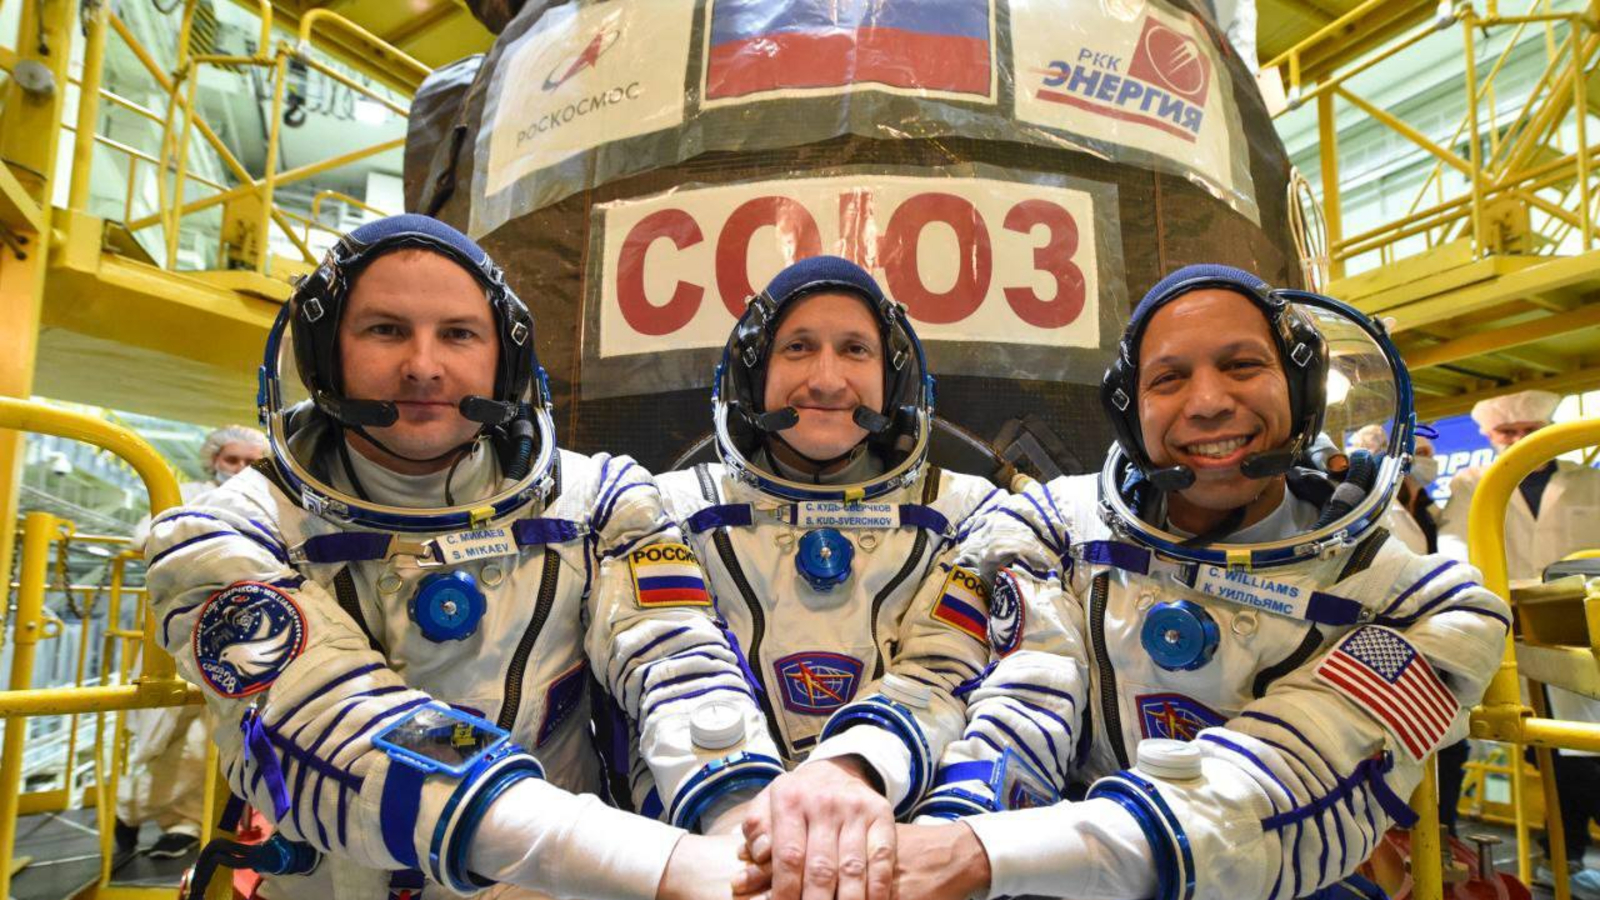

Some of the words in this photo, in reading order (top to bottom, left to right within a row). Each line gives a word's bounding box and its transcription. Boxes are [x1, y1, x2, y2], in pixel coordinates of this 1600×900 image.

[1078, 47, 1122, 71] РКК
[1043, 60, 1204, 134] ЭНЕРГИЯ
[516, 82, 640, 147] РОСКОСМОС
[617, 192, 1086, 336] СОЮЗ
[460, 529, 505, 542] МИКАЕВ
[806, 517, 815, 526] S.
[817, 517, 892, 526] KUD-SVERCHKOV
[452, 550, 465, 560] S.
[465, 543, 509, 557] MIKAEV
[1209, 567, 1220, 578] C.
[1225, 569, 1300, 598] WILLIAMS
[1204, 582, 1215, 595] К.
[1219, 586, 1294, 615] УИЛЛЬЯМС
